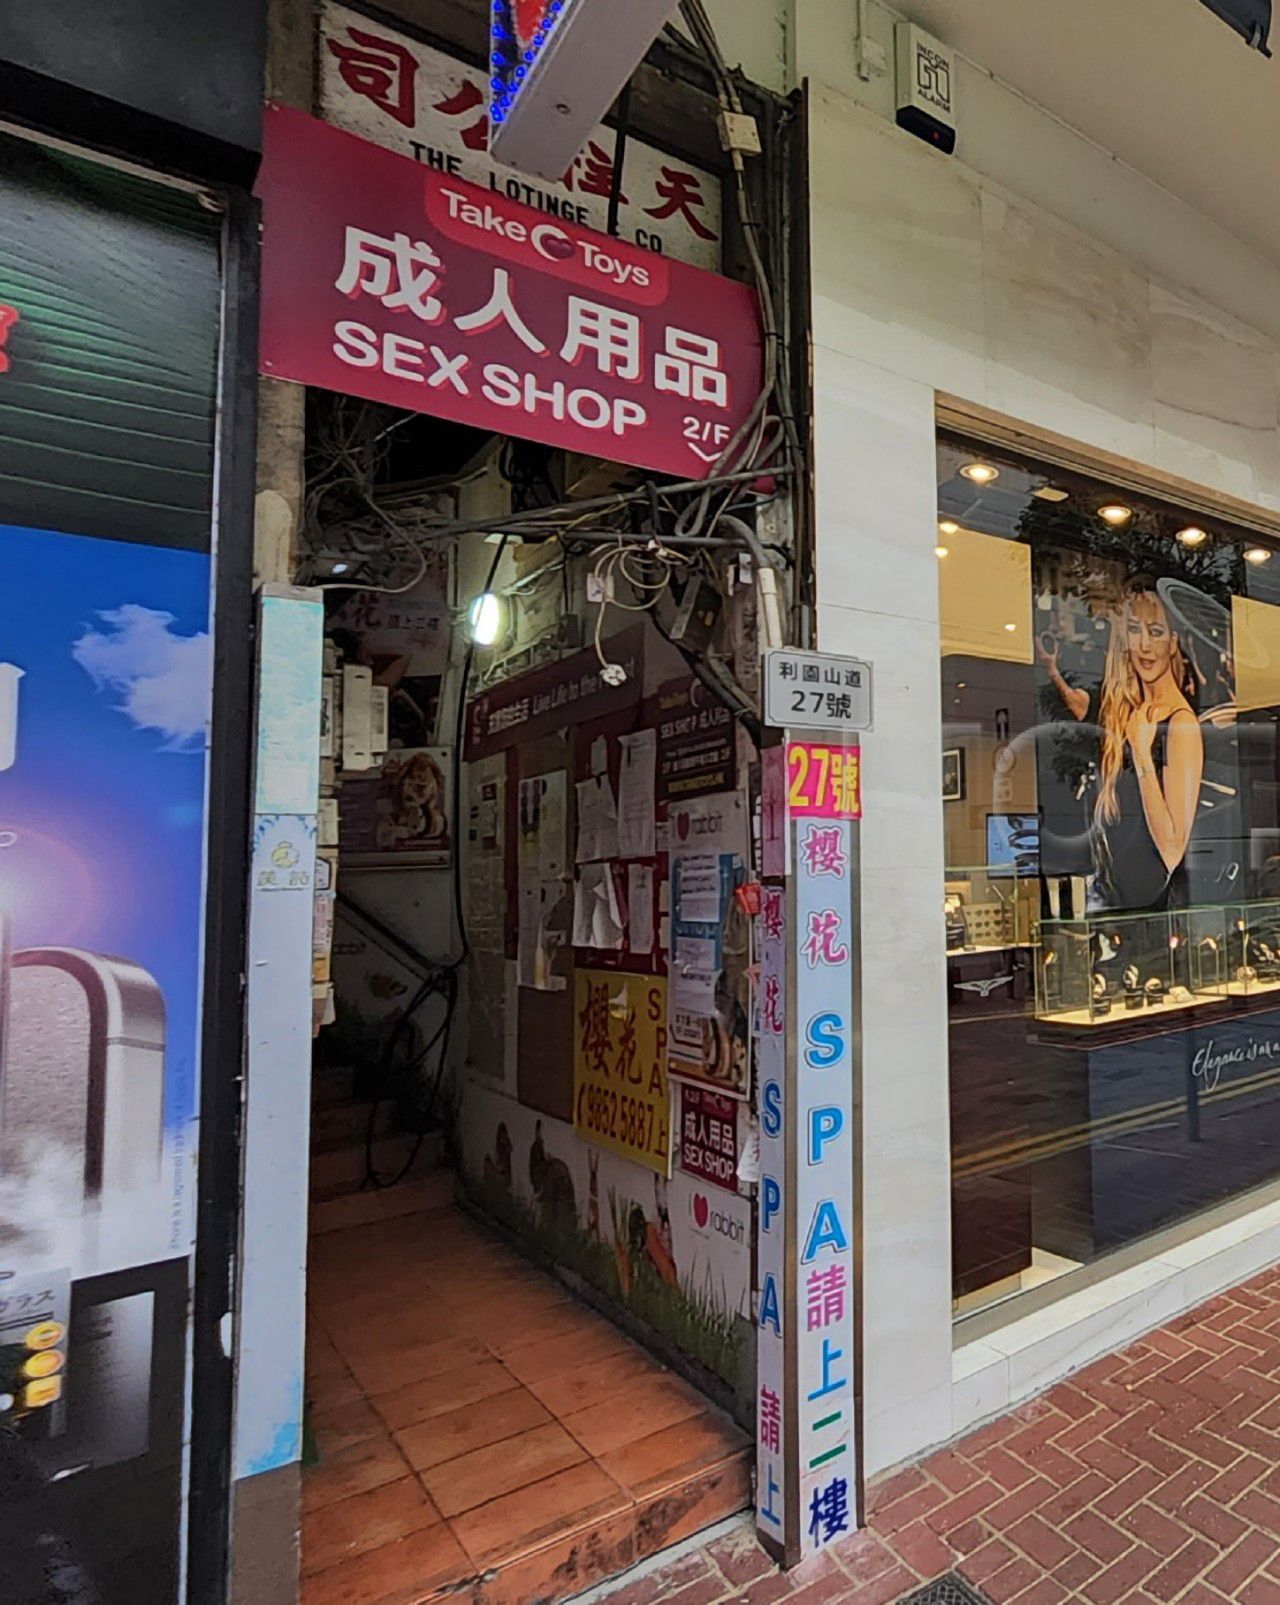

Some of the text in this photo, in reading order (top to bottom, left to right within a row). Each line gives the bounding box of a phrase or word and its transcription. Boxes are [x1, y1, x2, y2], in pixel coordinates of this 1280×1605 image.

[918, 88, 951, 114] ALARM
[409, 140, 663, 253] THE LOTINGE CO
[440, 188, 650, 287] Take Toys
[335, 226, 729, 408] 成人用品
[332, 320, 647, 436] SEX SHOP
[683, 416, 731, 446] 2/F
[779, 661, 862, 688] 利園山道
[791, 690, 852, 719] 27號
[788, 746, 860, 814] 27號
[647, 988, 668, 1098] SPA
[587, 1083, 617, 1139] 9852
[620, 1095, 655, 1153] 5887
[684, 1110, 735, 1158] 成人用品
[684, 1143, 735, 1183] SEX SHOP
[710, 1208, 745, 1244] rabbit
[807, 1264, 849, 1549] 請上二樓
